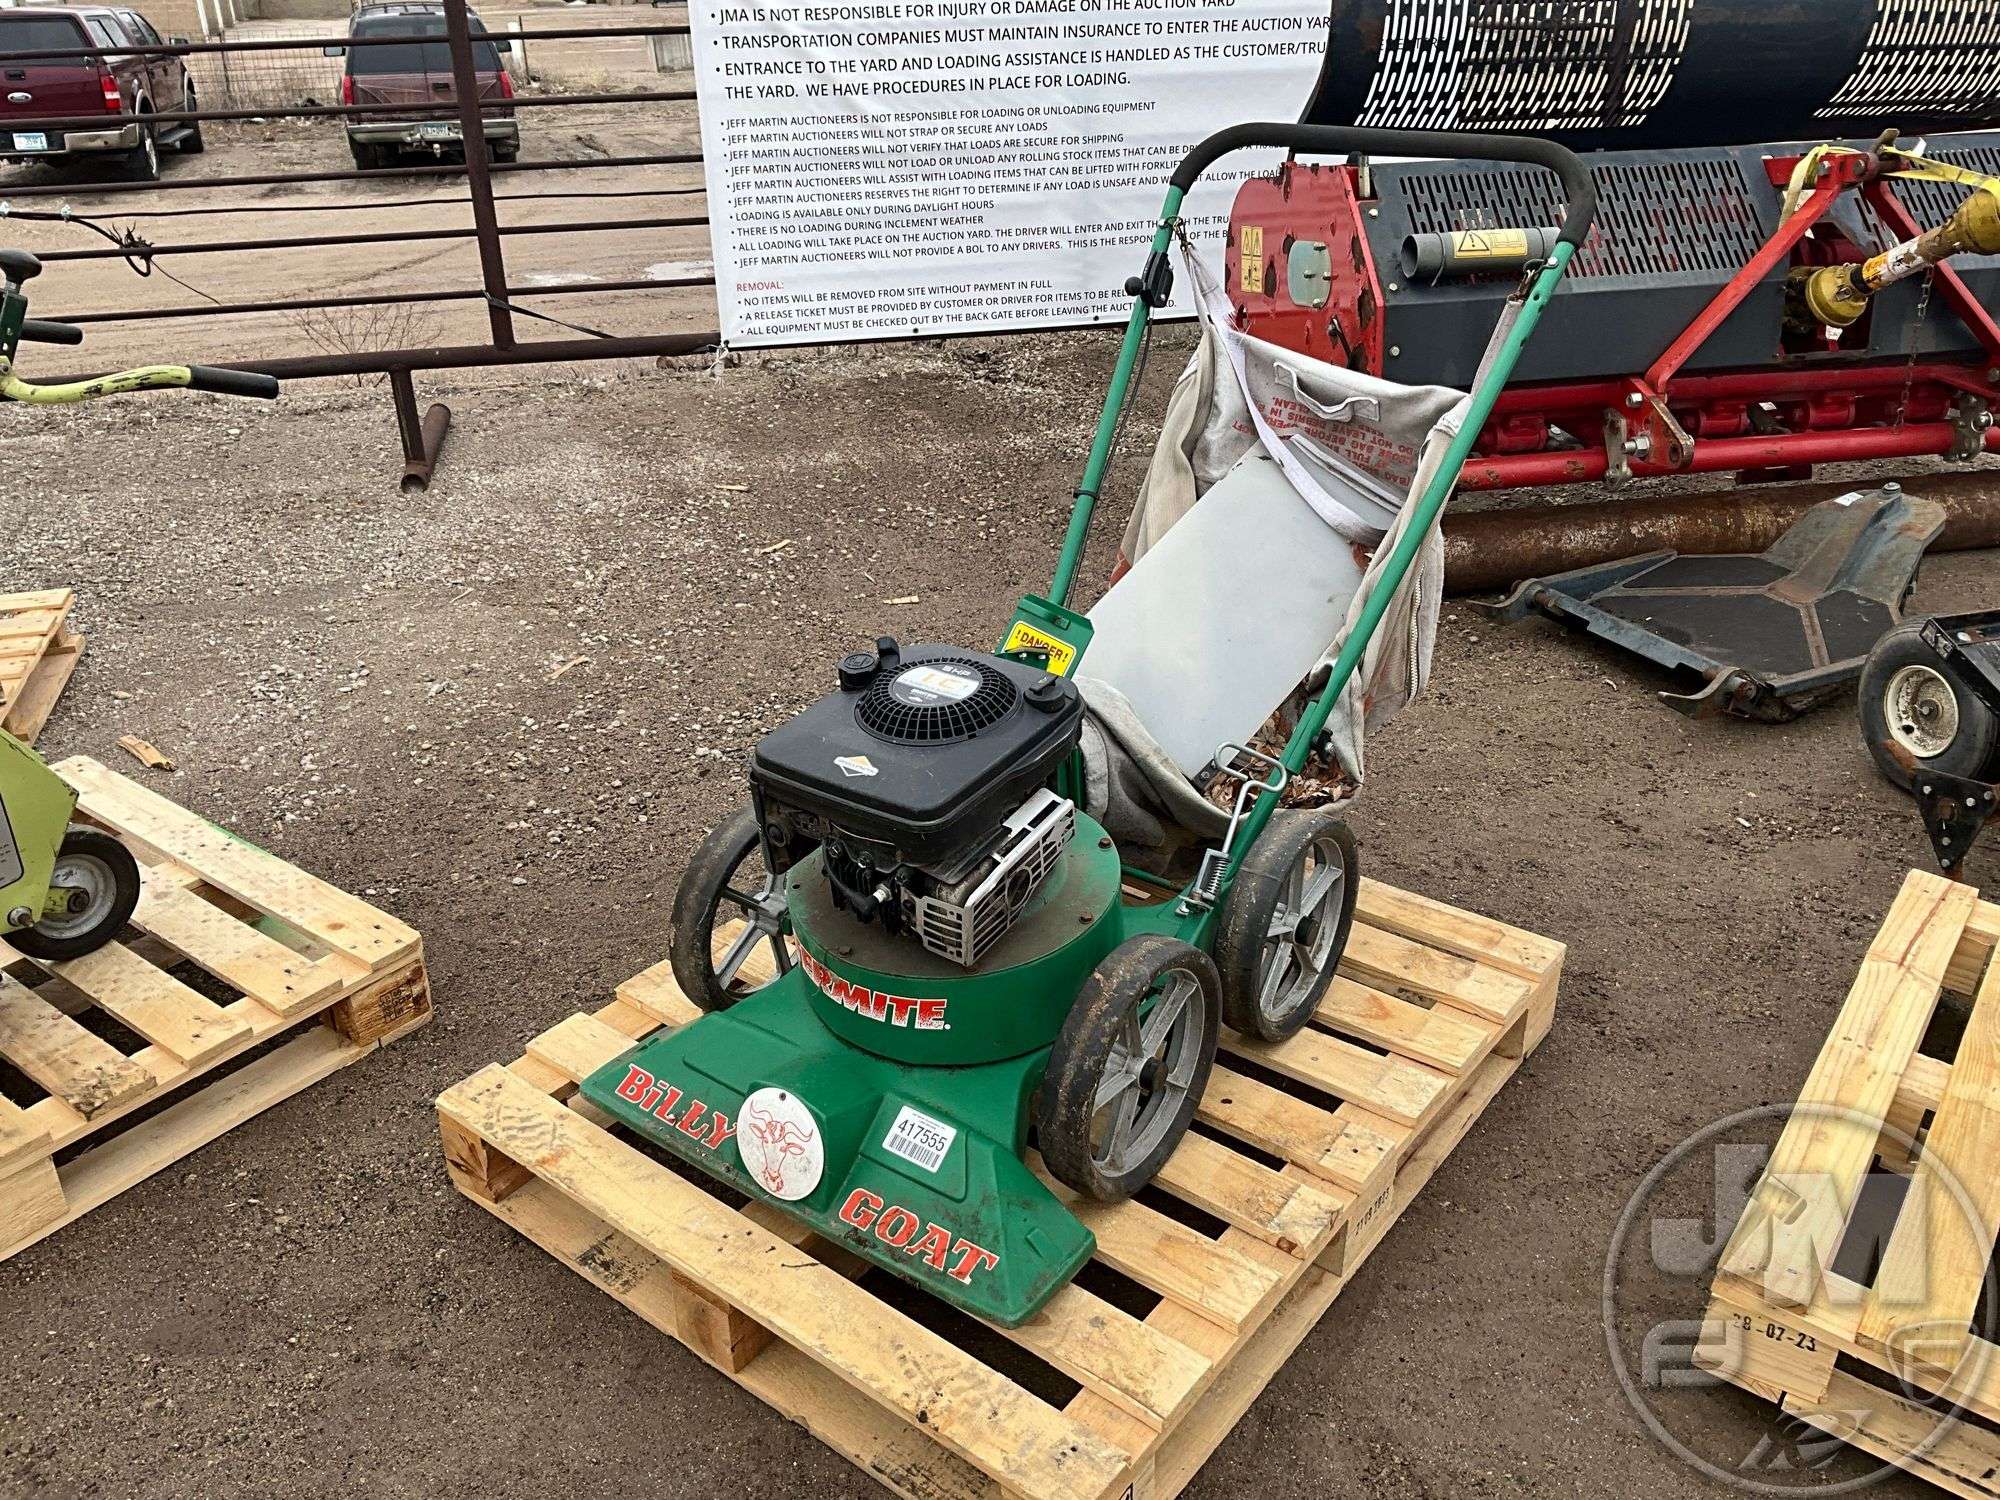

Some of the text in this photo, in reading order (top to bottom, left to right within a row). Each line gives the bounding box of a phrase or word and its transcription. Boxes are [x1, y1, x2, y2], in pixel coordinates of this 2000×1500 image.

[720, 8, 749, 24] JMA
[753, 8, 766, 22] IS
[770, 8, 800, 22] NOT
[804, 5, 901, 21] RESPONSIBLE
[906, 4, 934, 18] FOR
[938, 2, 986, 18] INJURY
[990, 1, 1011, 15] OR
[1015, 0, 1076, 14] DAMAGE
[1080, 0, 1101, 12] ON
[1106, 0, 1131, 10] THE
[1134, 0, 1196, 9] AUCTION
[722, 16, 1330, 49] TRANSPORTATION COMPANIES MUST MAINTAIN INSURANCE TO ENTER THE AUCTION YAR
[725, 41, 1325, 76] ENTRANCE TO THE YARD AND LOADING ASSISTANCE IS HANDLED AS THE CUSTOMER/TRU
[724, 71, 1131, 99] THE YARD. WE HAVE PROCEDURES IN PLACE FOR LOADING.
[726, 101, 1156, 130] JEFF MARTIN AUCTIONEERS IS NOT RESPONSIBLE FOR LOADING OR UNLOADING EQUIPMENT
[728, 122, 1048, 146] JEFF MARTIN AUCTIONEERS WILL NOT STRAP OR SECURE ANY LOADS
[729, 133, 1124, 162] JEFF MARTIN AUCTIONEERS WILL NOT VERIFY THAT LOADS ARE SECURE FOR SHIPPING
[732, 162, 1140, 192] JEFF MARTIN AUCTIONEERS WILL ASSIST WITH LOADING ITEMS THAT CAN BE LIFTED WITH
[736, 200, 994, 221] LOADING IS AVAILABLE ONLY DURING DAYLIGHT HOURS
[737, 215, 984, 236] THERE IS NO LOADING DURING INCLEMENT WEATHER
[744, 280, 1053, 306] NO ITEMS WILL BE REMOVED FROM SITE WITHOUT PAYMENT IN FULL
[747, 304, 1108, 335] ALL EQUIPMENT MUST BE CHECKED OUT BY THE BACK GATE BEFORE LEAVING THE
[1287, 411, 1327, 428] DEBRIS
[1332, 424, 1365, 439] LEAVE
[1304, 426, 1346, 446] BEFORE
[797, 942, 948, 1030] ERMITE
[897, 1119, 948, 1153] 417555
[838, 1187, 1000, 1286] GOAT
